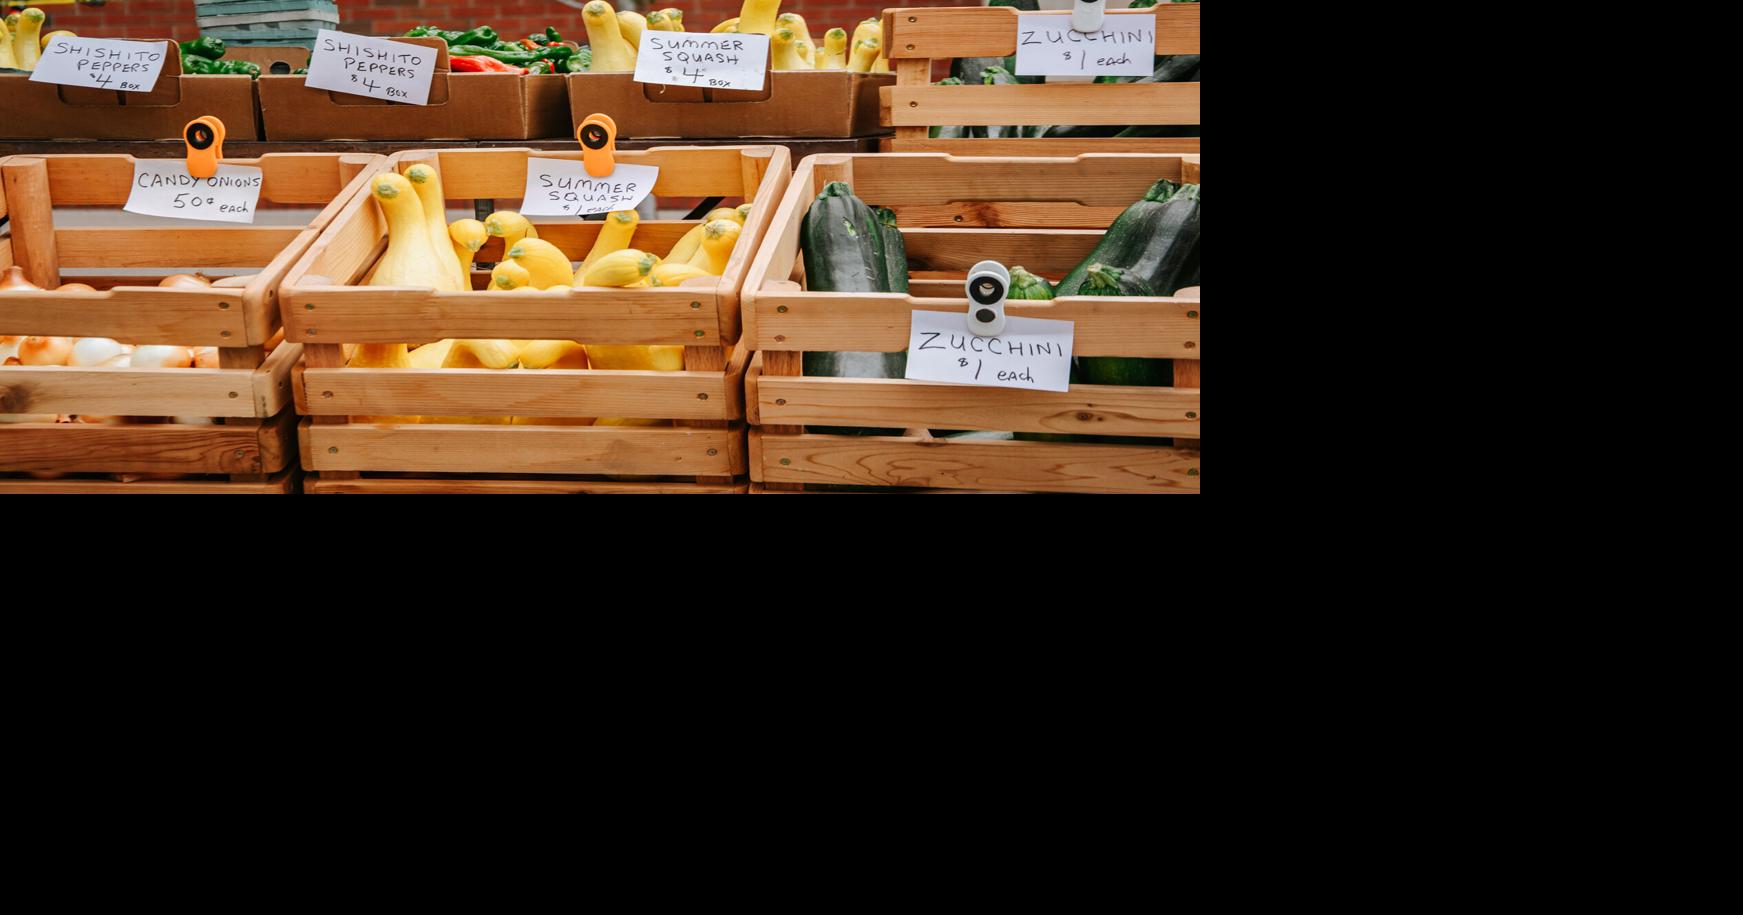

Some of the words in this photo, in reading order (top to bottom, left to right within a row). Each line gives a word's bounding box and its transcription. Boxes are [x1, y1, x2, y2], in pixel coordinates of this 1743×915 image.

[53, 42, 160, 62] SHISHITO
[323, 39, 423, 65] SHISHITO
[650, 38, 744, 52] SUMMER
[77, 59, 149, 73] PEPPERS
[663, 51, 739, 65] SQUASH
[344, 57, 416, 79] PEPPERS
[138, 172, 201, 190] CANDY
[207, 177, 261, 189] ONIONS
[539, 174, 637, 194] SUMMER
[549, 191, 634, 204] SQUASH
[916, 331, 1065, 357] ZUCCHINI
